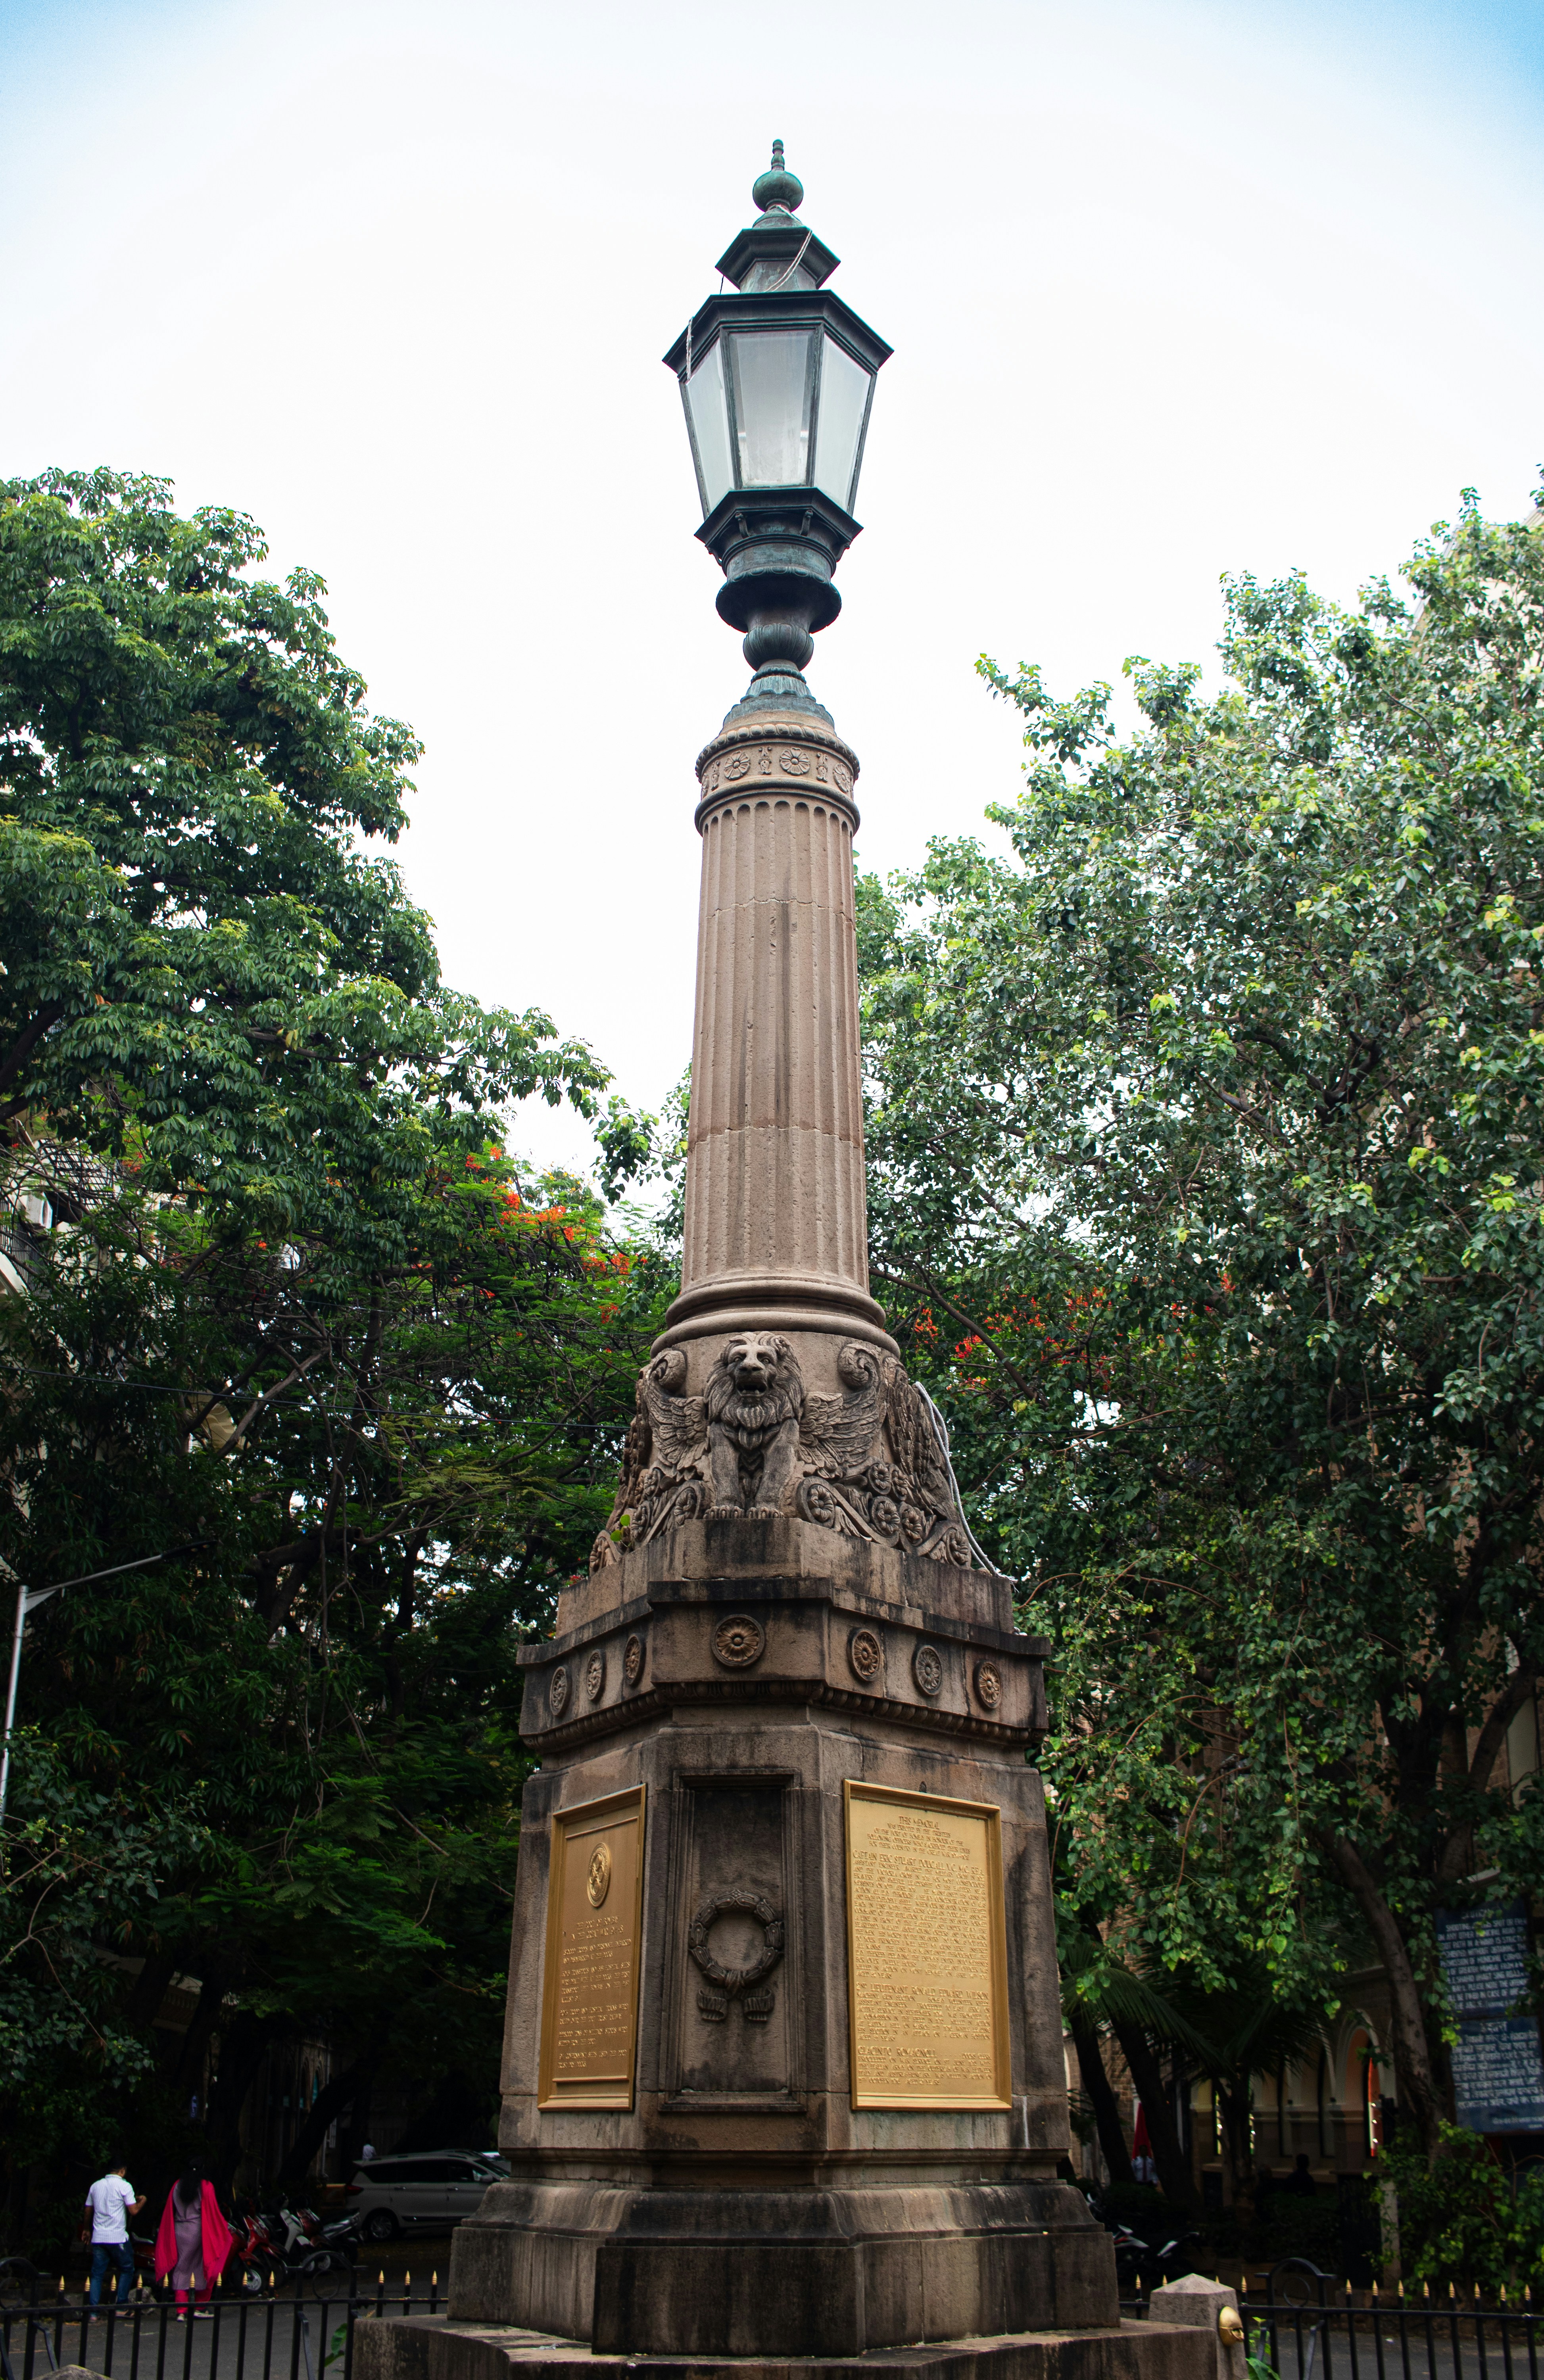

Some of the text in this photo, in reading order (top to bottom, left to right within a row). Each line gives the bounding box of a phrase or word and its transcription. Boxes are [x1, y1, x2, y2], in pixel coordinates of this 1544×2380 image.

[899, 1816, 939, 1829] THIS MEMORIAL
[852, 1849, 877, 1861] CAPTAIN
[879, 1852, 892, 1863] ERIC
[894, 1855, 916, 1866] STUART
[918, 1858, 944, 1870] DOUGALL
[870, 1983, 908, 1994] LIEUTENANT
[911, 1986, 935, 1996] RONALD
[939, 1988, 963, 1998] EDWARD
[966, 1990, 988, 2000] WILSON
[857, 2045, 891, 2056] GIACINTO
[896, 2047, 936, 2058] ROMAGNOLI
